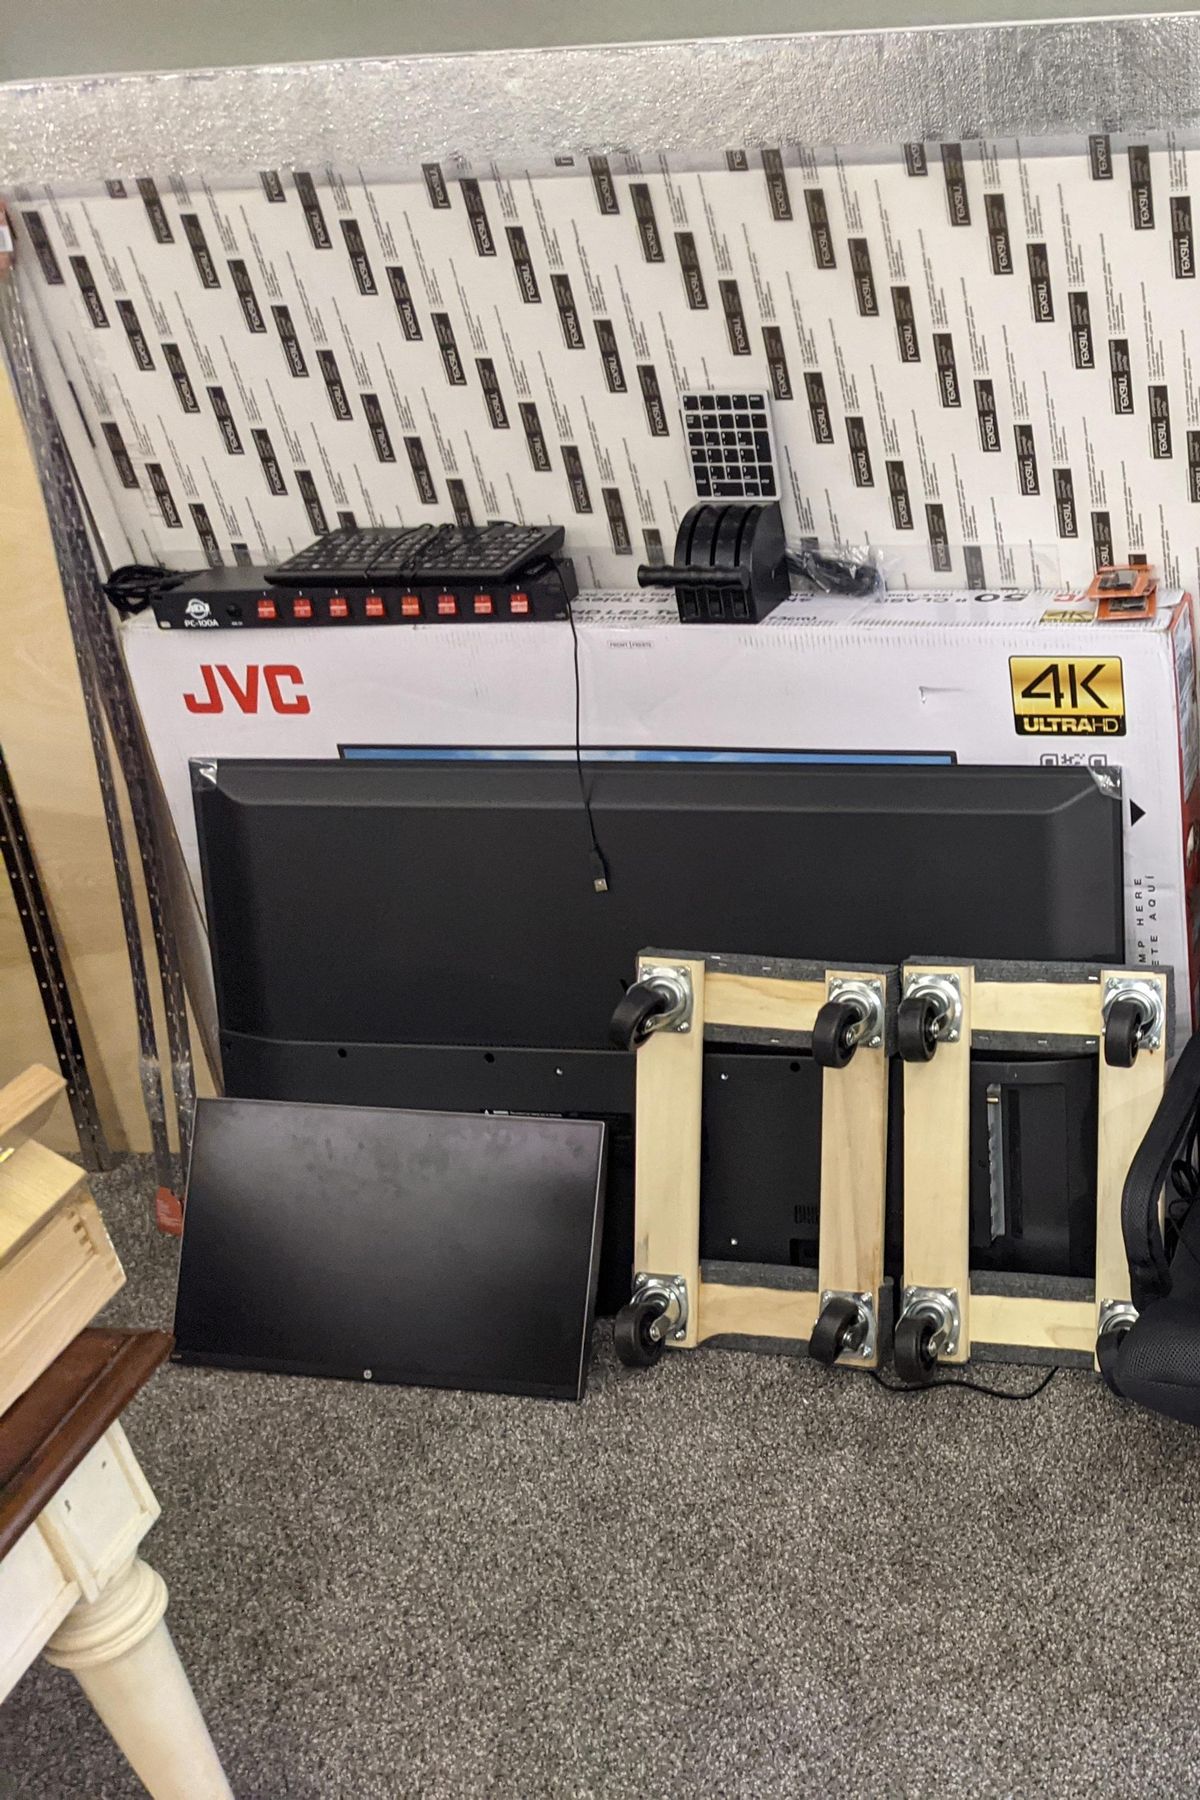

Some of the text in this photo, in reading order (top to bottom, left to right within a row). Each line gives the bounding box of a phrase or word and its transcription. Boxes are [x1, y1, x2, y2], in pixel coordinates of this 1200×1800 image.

[183, 664, 311, 714] JVC
[1021, 664, 1110, 709] 4K
[1133, 878, 1144, 926] HERE
